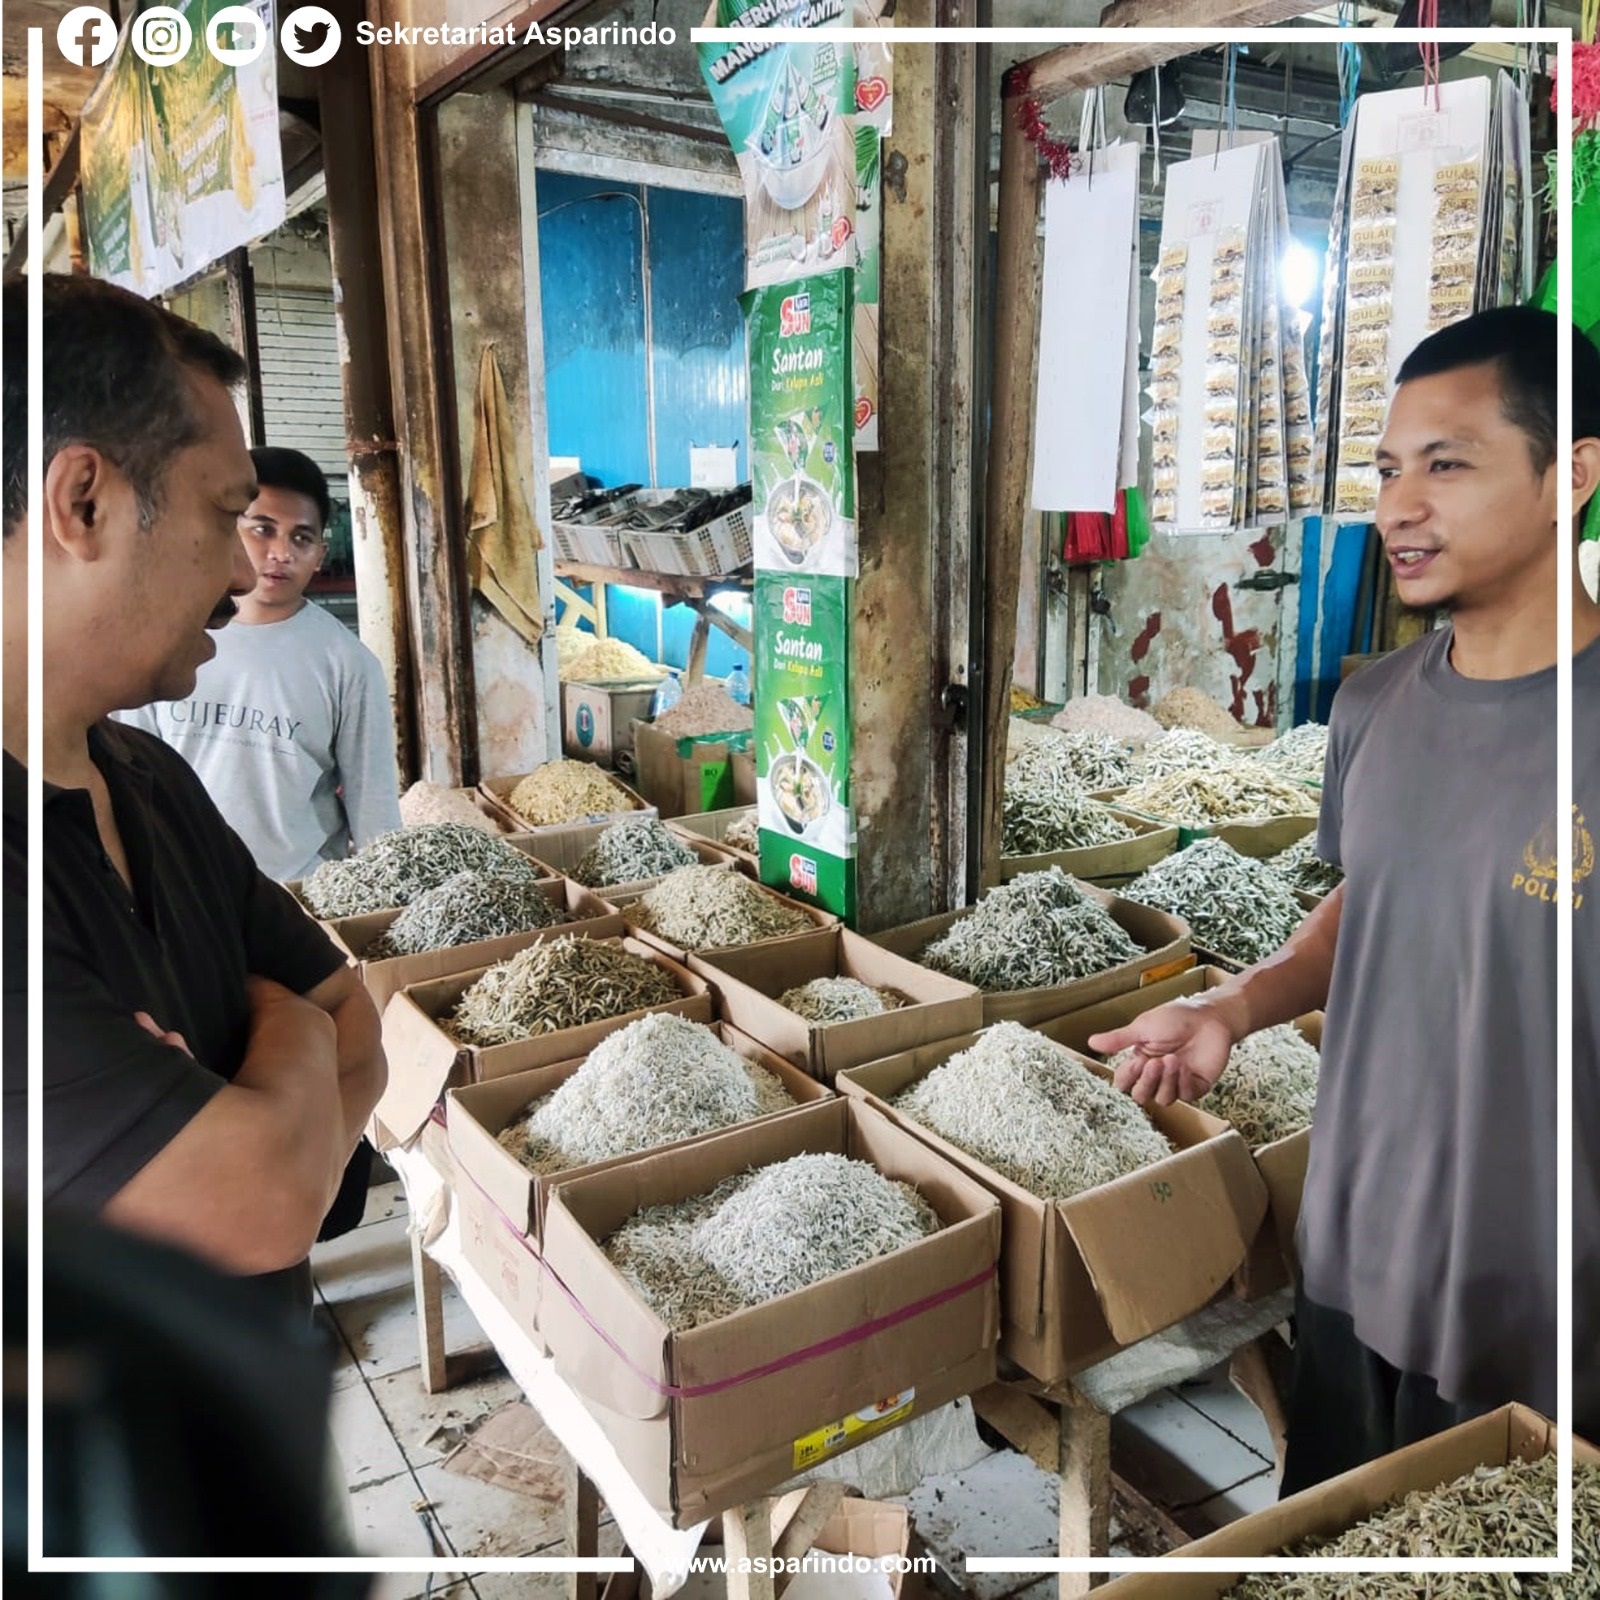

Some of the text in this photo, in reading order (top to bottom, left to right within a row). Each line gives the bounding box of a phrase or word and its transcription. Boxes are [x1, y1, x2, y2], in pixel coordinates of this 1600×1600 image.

[1361, 164, 1397, 175] GULAI
[1354, 229, 1389, 241] GULAI
[1355, 267, 1391, 278] GULAI
[1352, 305, 1388, 321] GULAI
[771, 345, 823, 375] Santan
[1343, 443, 1373, 456] GULA
[774, 630, 823, 661] Santan
[170, 701, 303, 740] CIJEURAY
[1511, 873, 1584, 910] POLII
